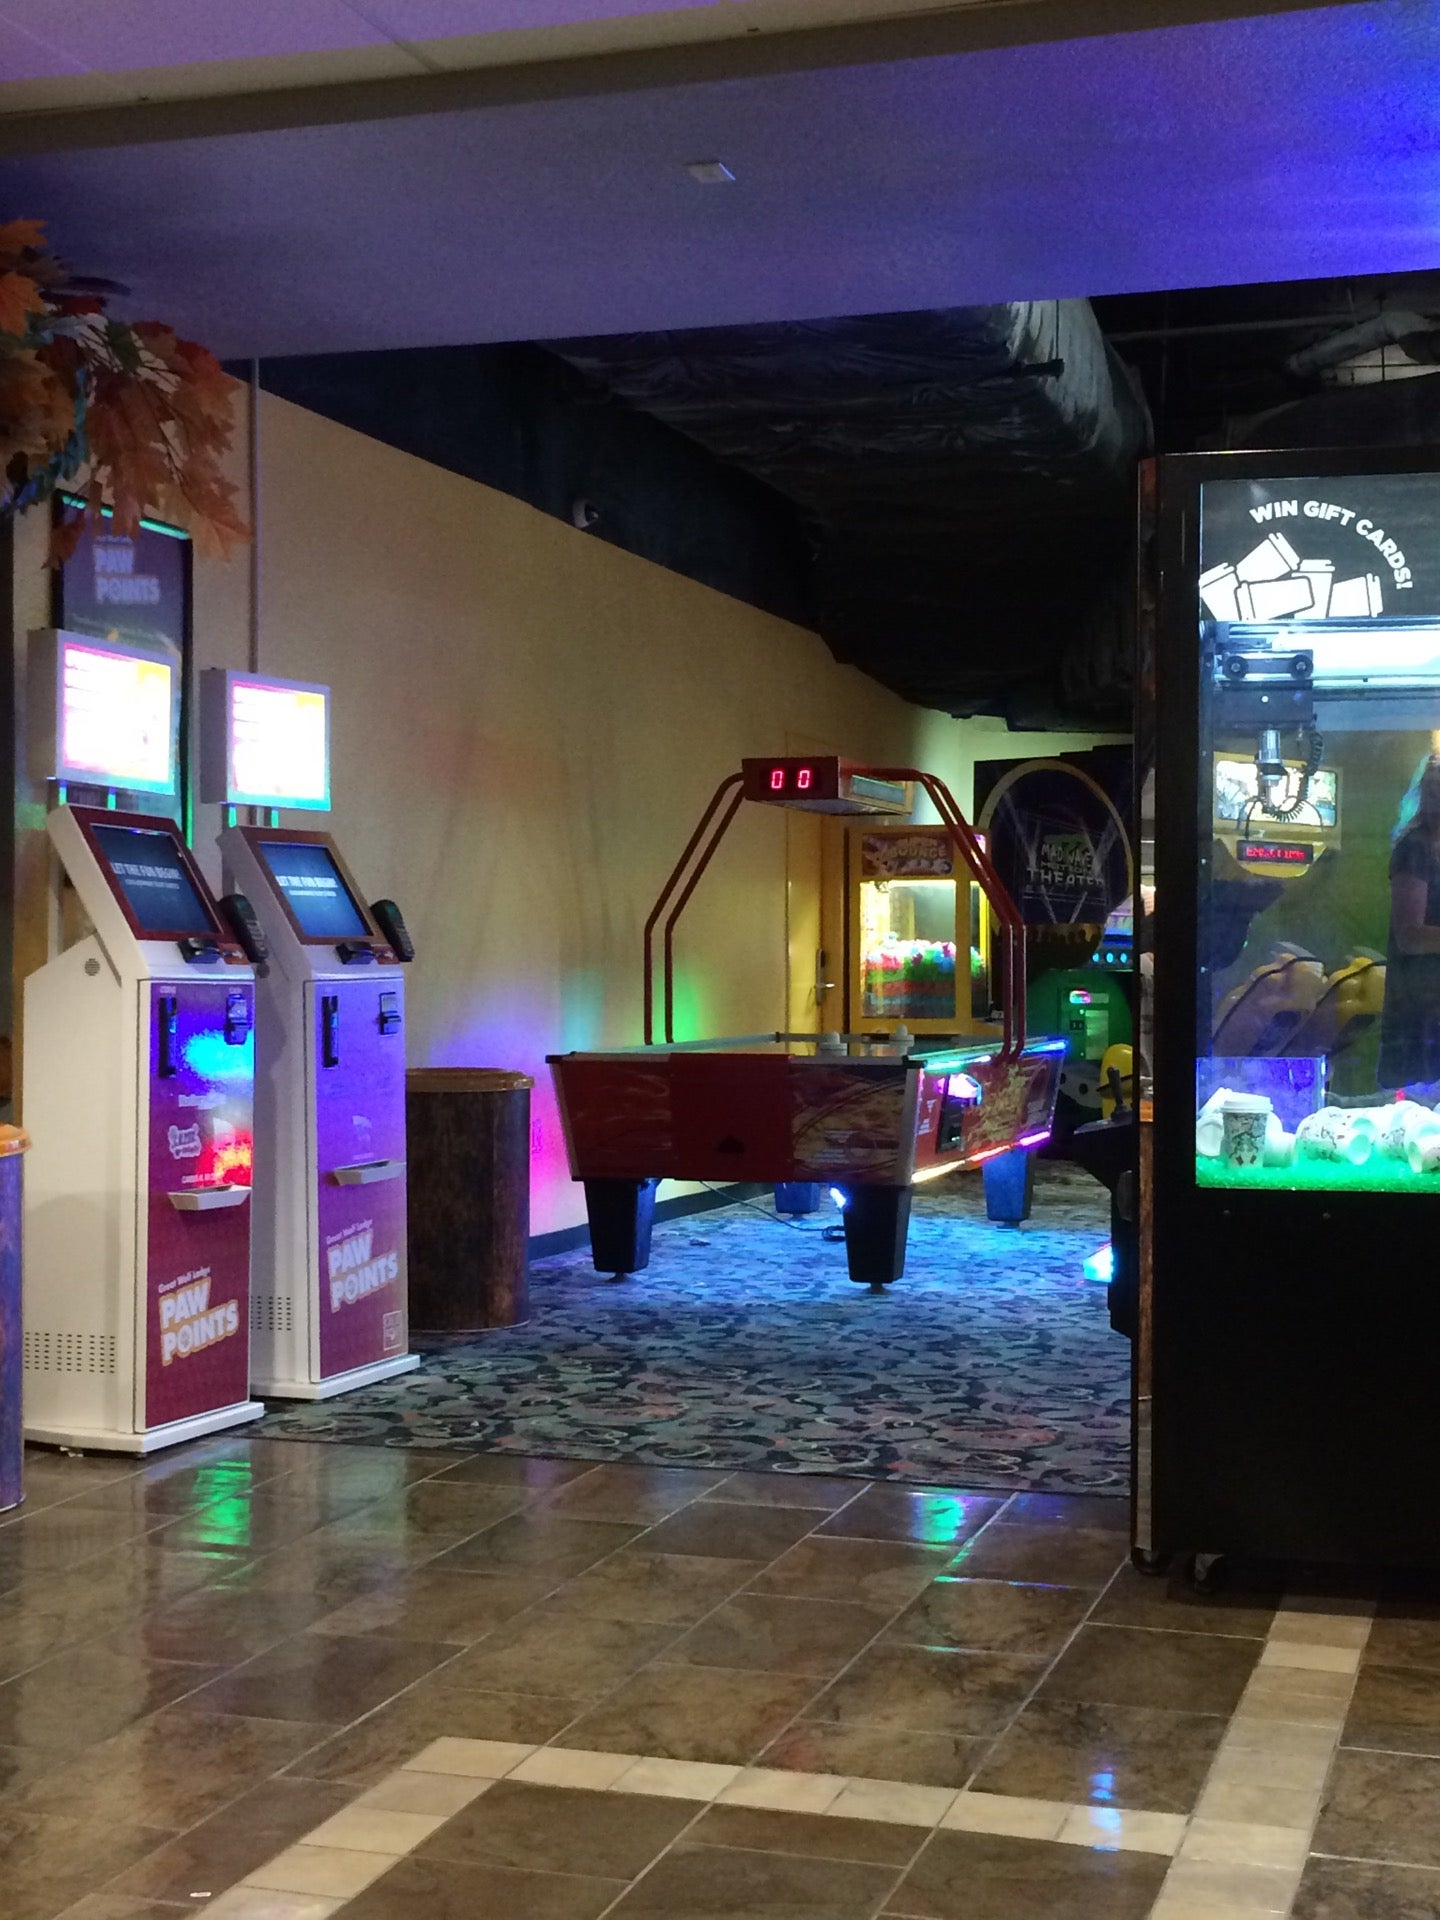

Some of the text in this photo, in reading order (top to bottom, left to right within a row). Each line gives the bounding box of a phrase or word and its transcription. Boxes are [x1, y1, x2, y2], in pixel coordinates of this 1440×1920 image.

[94, 547, 134, 573] PAW
[1249, 499, 1413, 590] WIN GIFT CARDS!
[96, 576, 160, 604] POINTS
[329, 1232, 373, 1278] PAW
[330, 1251, 398, 1310] POINTS
[160, 1279, 210, 1330] PAW
[162, 1301, 238, 1362] POINTS
